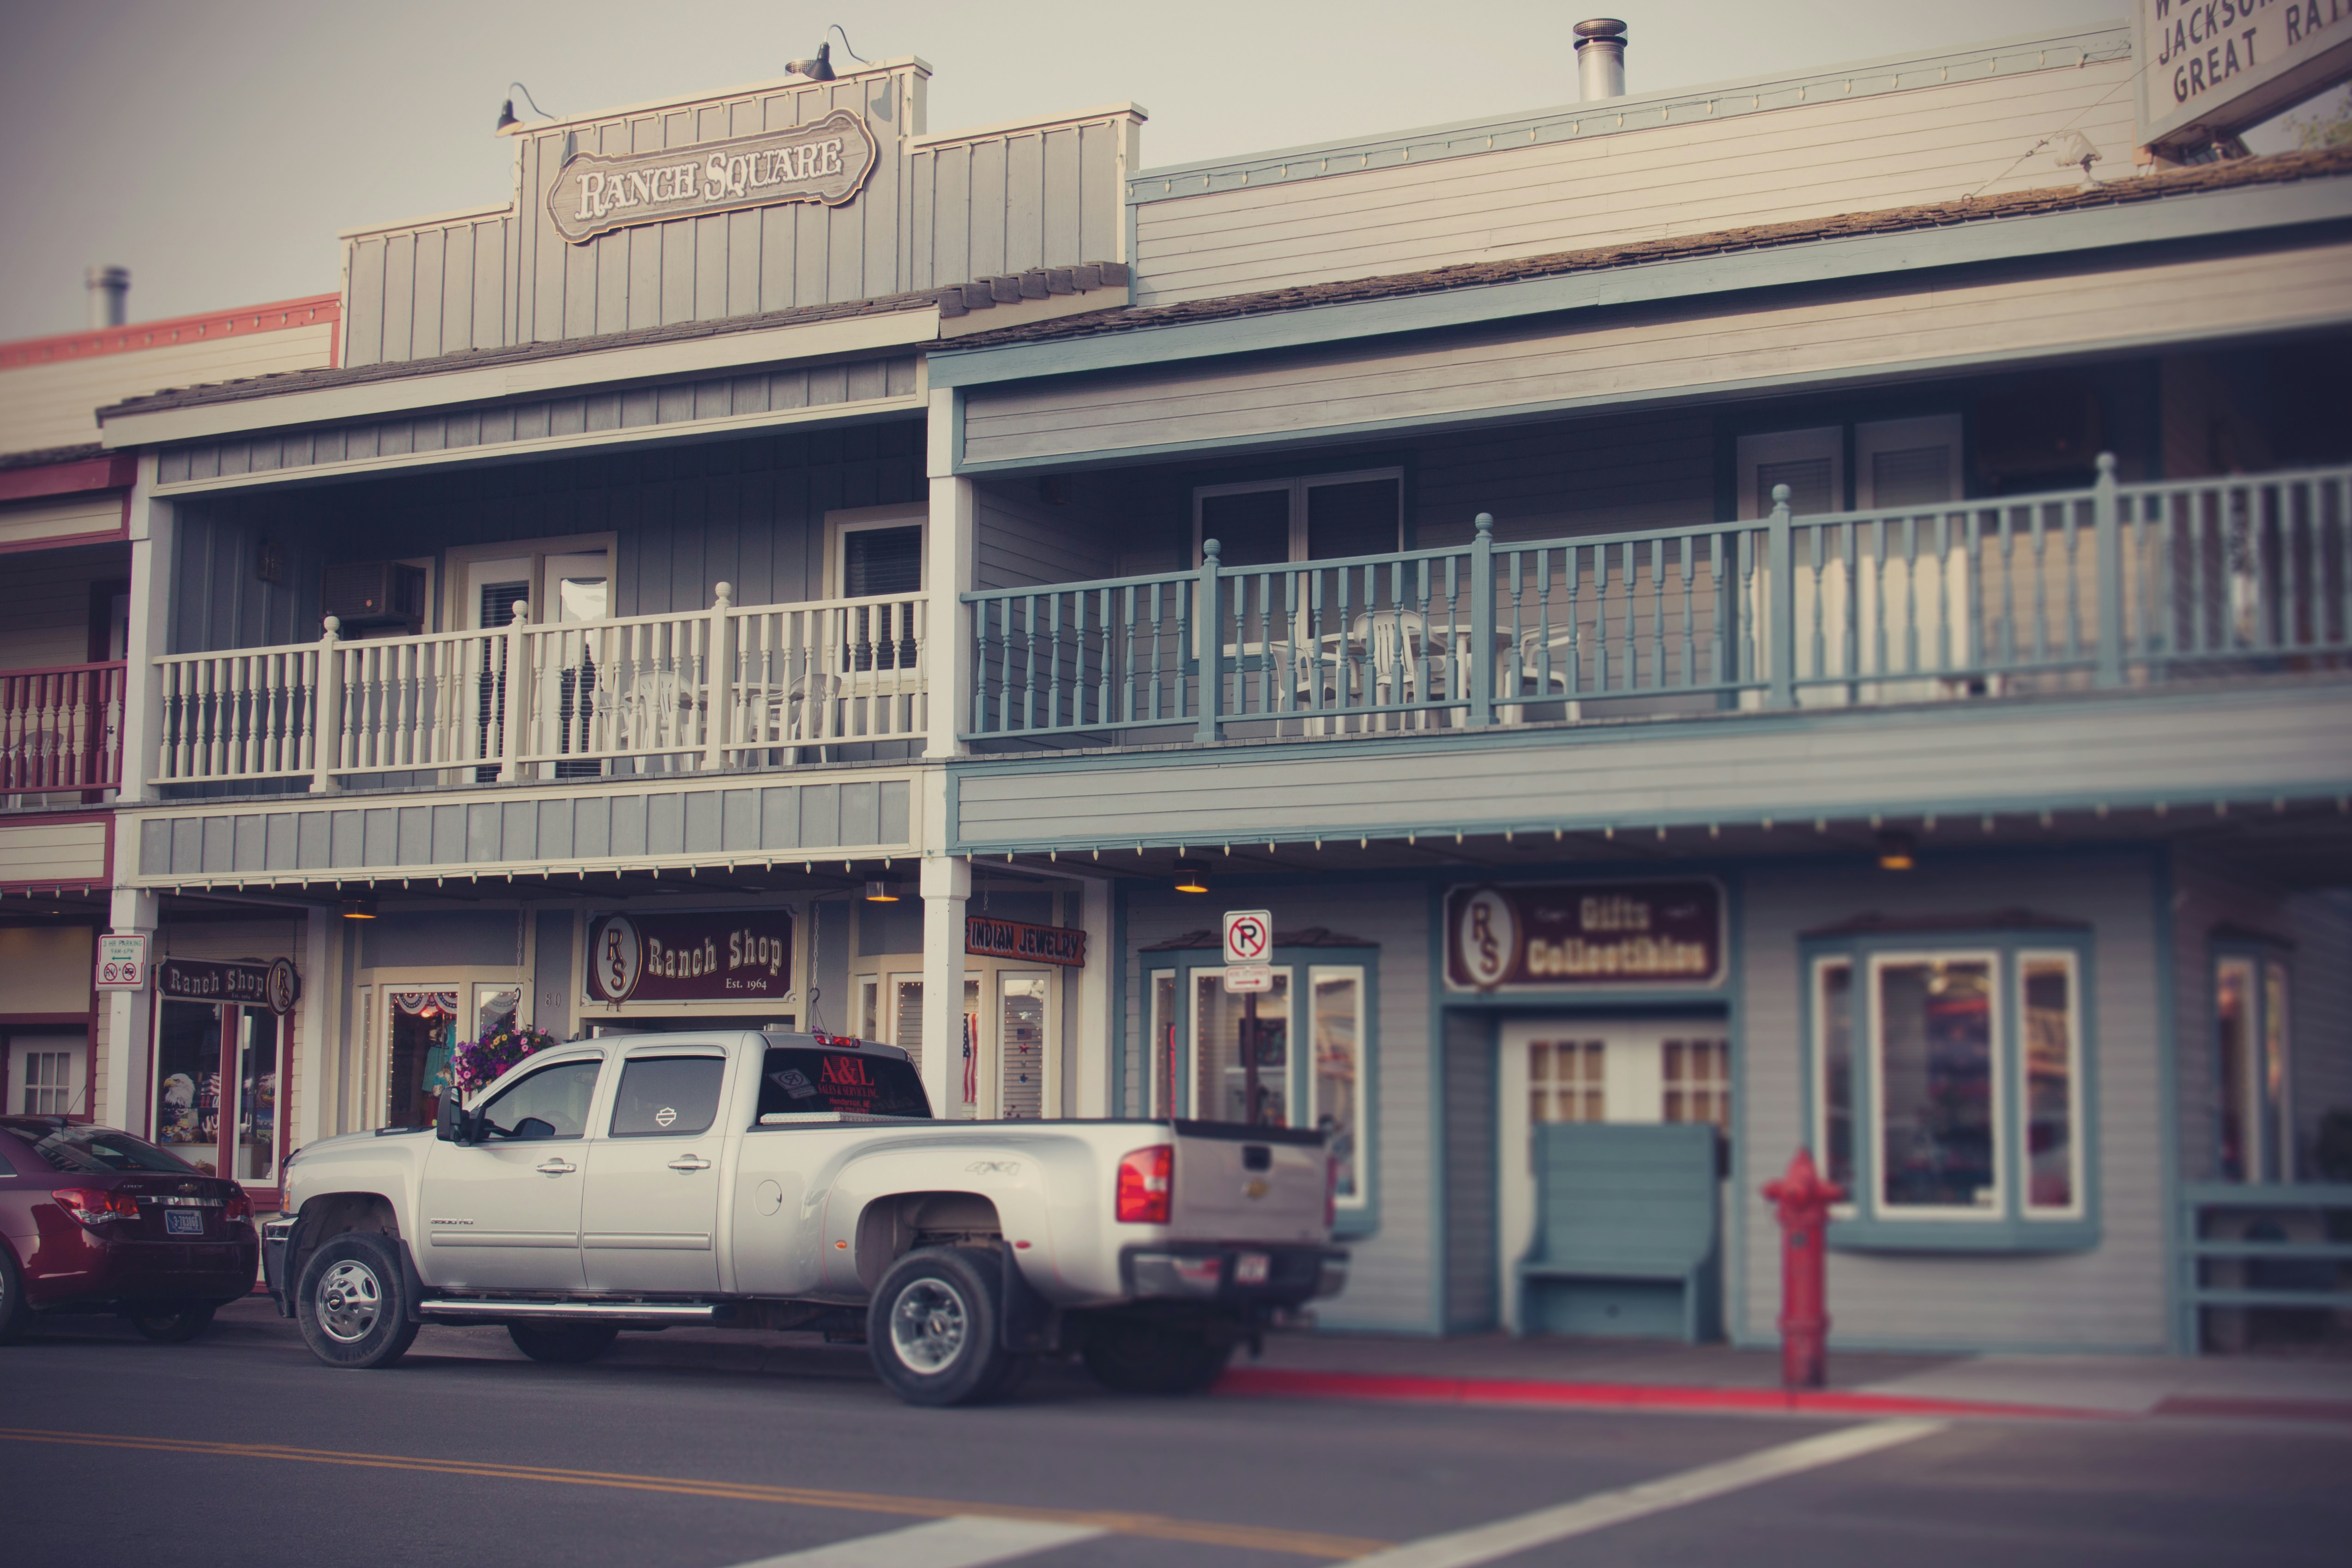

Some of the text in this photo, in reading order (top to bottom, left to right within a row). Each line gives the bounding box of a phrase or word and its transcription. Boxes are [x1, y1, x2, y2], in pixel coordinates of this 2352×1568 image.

[2159, 0, 2275, 66] JACKSO
[2173, 0, 2352, 103] GREAT RA
[574, 138, 844, 220] RANCH SQUARE
[648, 928, 782, 978] Ranch Shop
[970, 921, 1079, 961] INDIAN JEWELRY
[170, 967, 263, 998] Ranch Shop
[726, 978, 767, 991] Est. 1964
[818, 1084, 836, 1095] SALES
[838, 1085, 842, 1095] &
[843, 1086, 867, 1097] SERVICE
[820, 1056, 874, 1086] A&L
